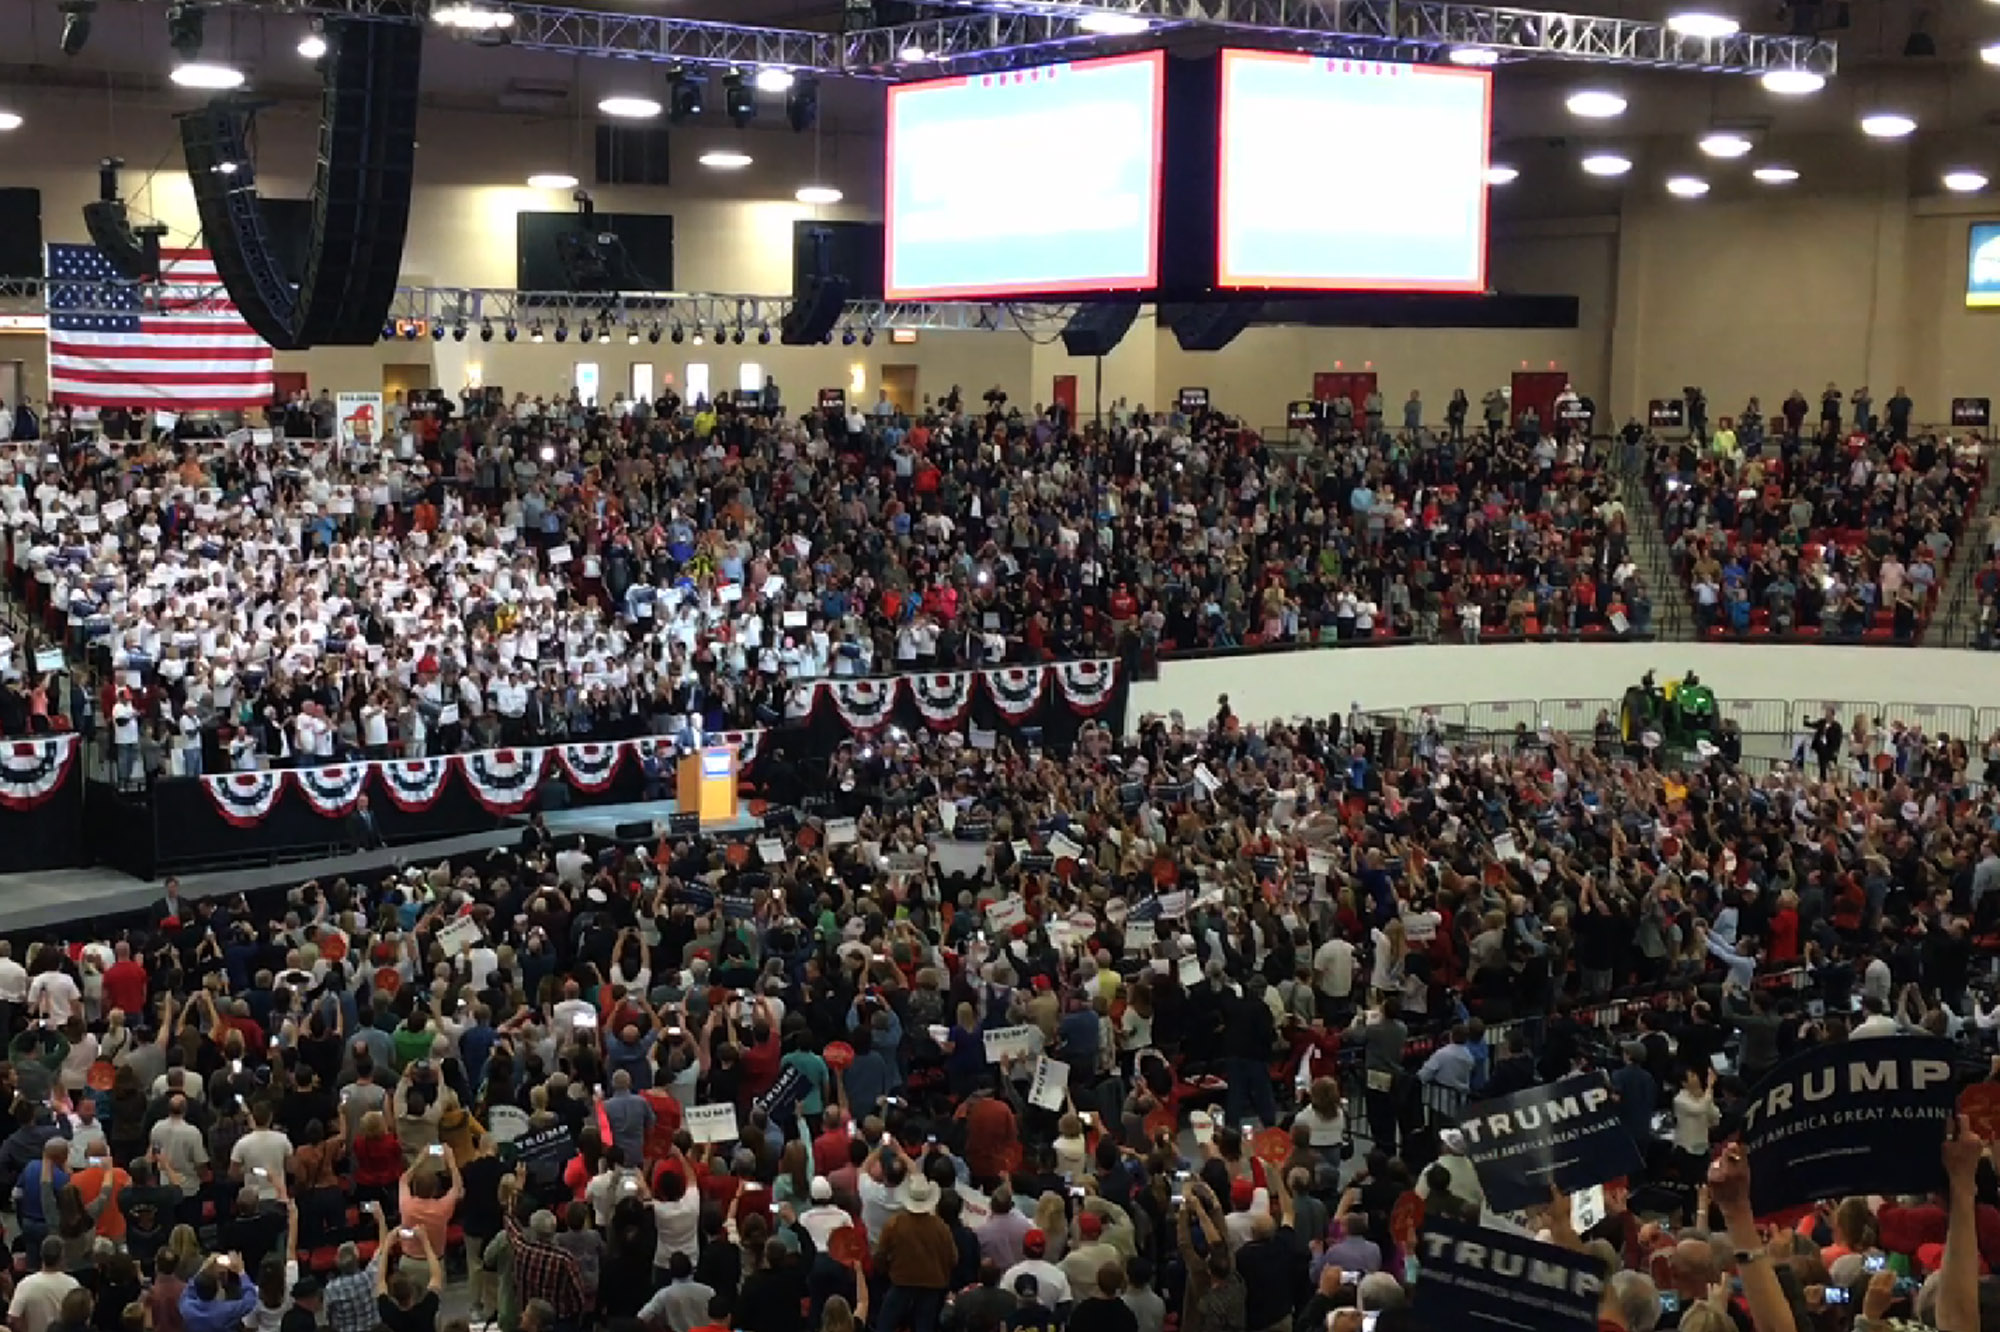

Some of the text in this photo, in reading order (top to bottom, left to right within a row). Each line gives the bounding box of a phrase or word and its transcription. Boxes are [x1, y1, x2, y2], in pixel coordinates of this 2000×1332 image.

[761, 1067, 796, 1108] TRUMP
[1745, 1060, 1950, 1130] TRUMP
[687, 1107, 732, 1119] TRUMP
[1462, 1088, 1608, 1143] TRUMP
[1767, 1113, 1828, 1145] AMERICA
[1833, 1107, 1885, 1125] GREAT
[515, 1125, 569, 1149] TRUMP
[1422, 1231, 1602, 1298] TRUMP
